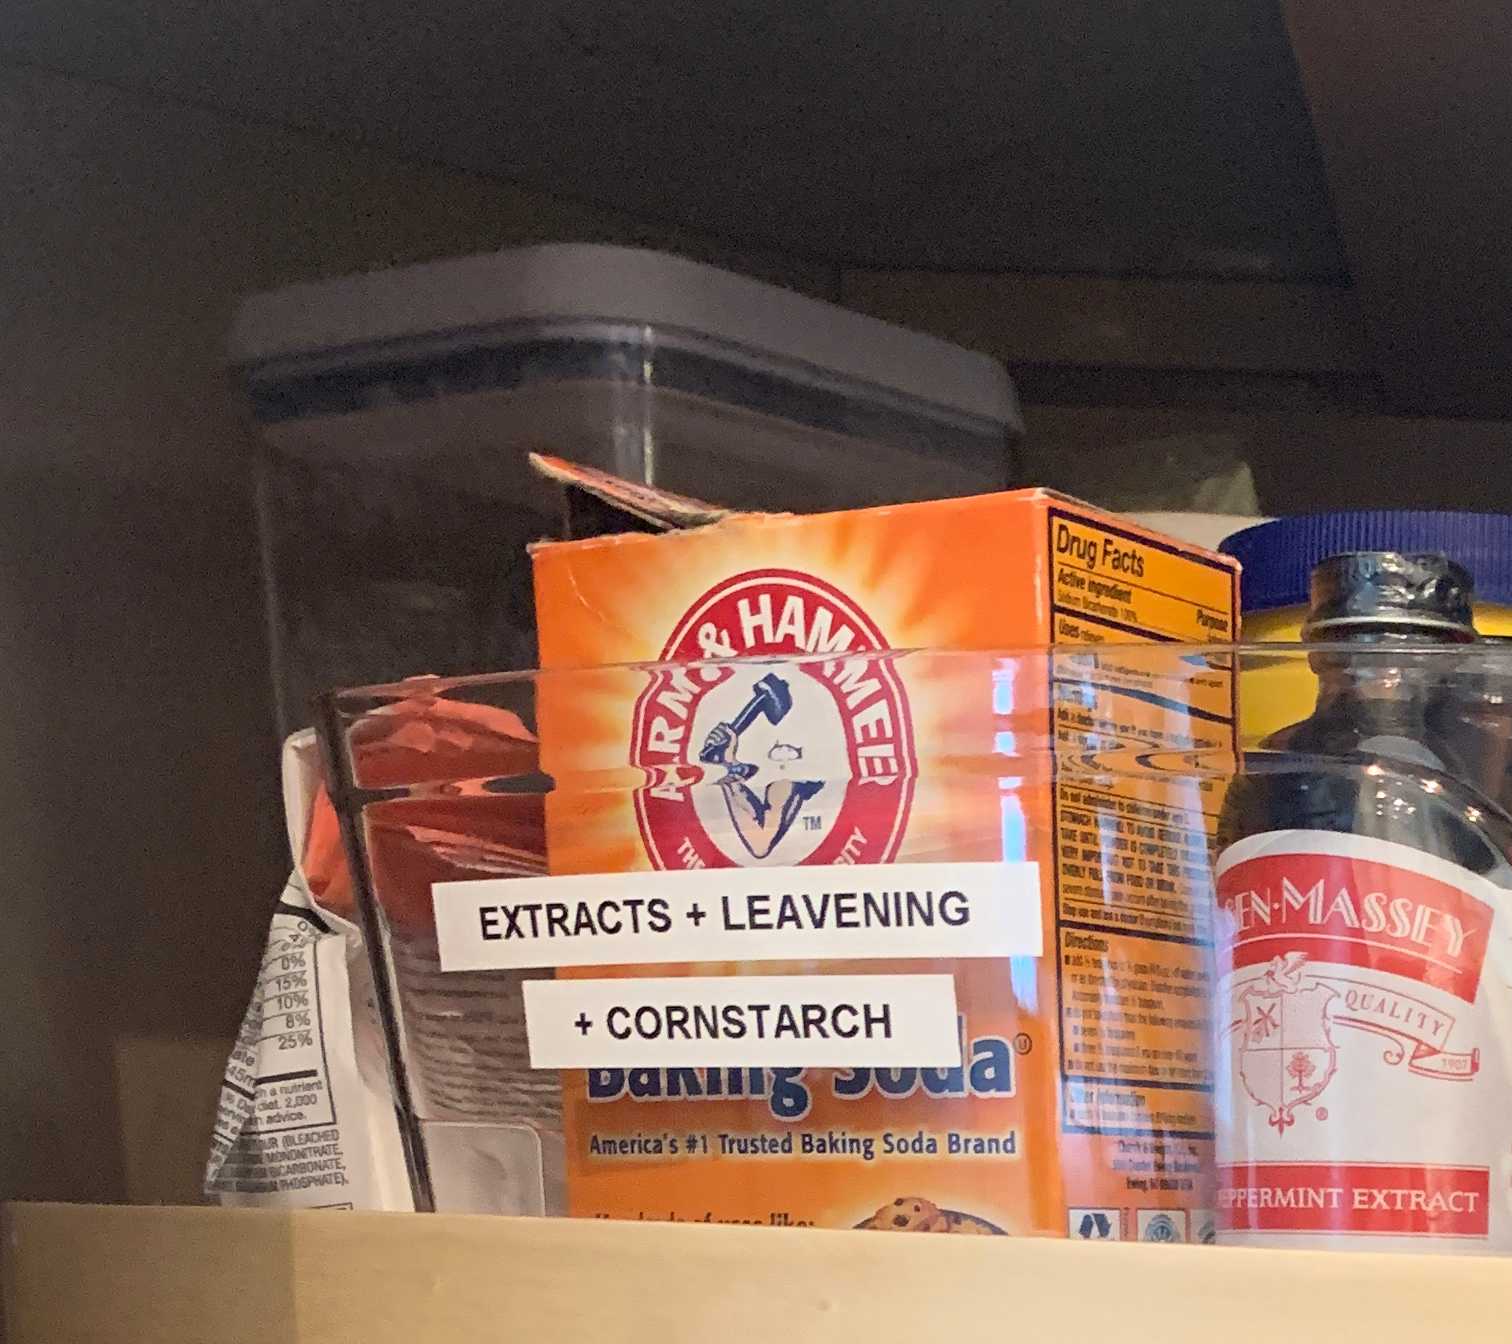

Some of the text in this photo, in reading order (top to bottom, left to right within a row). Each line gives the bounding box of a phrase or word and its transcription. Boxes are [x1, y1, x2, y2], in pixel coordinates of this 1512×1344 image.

[1056, 523, 1145, 578] Drug Facts
[1057, 567, 1086, 591] Active
[479, 889, 971, 941] EXTRACTS + LEAVENING
[276, 991, 310, 1010] 10%
[1344, 989, 1446, 1037] QUALITY
[573, 1003, 894, 1040] + CORNSTARCH
[278, 1030, 314, 1051] 25%
[279, 1080, 323, 1094] nutrient
[589, 1130, 1017, 1160] America's #1 Trusted Baking Soda Brand
[1351, 1189, 1480, 1213] EXTRACT
